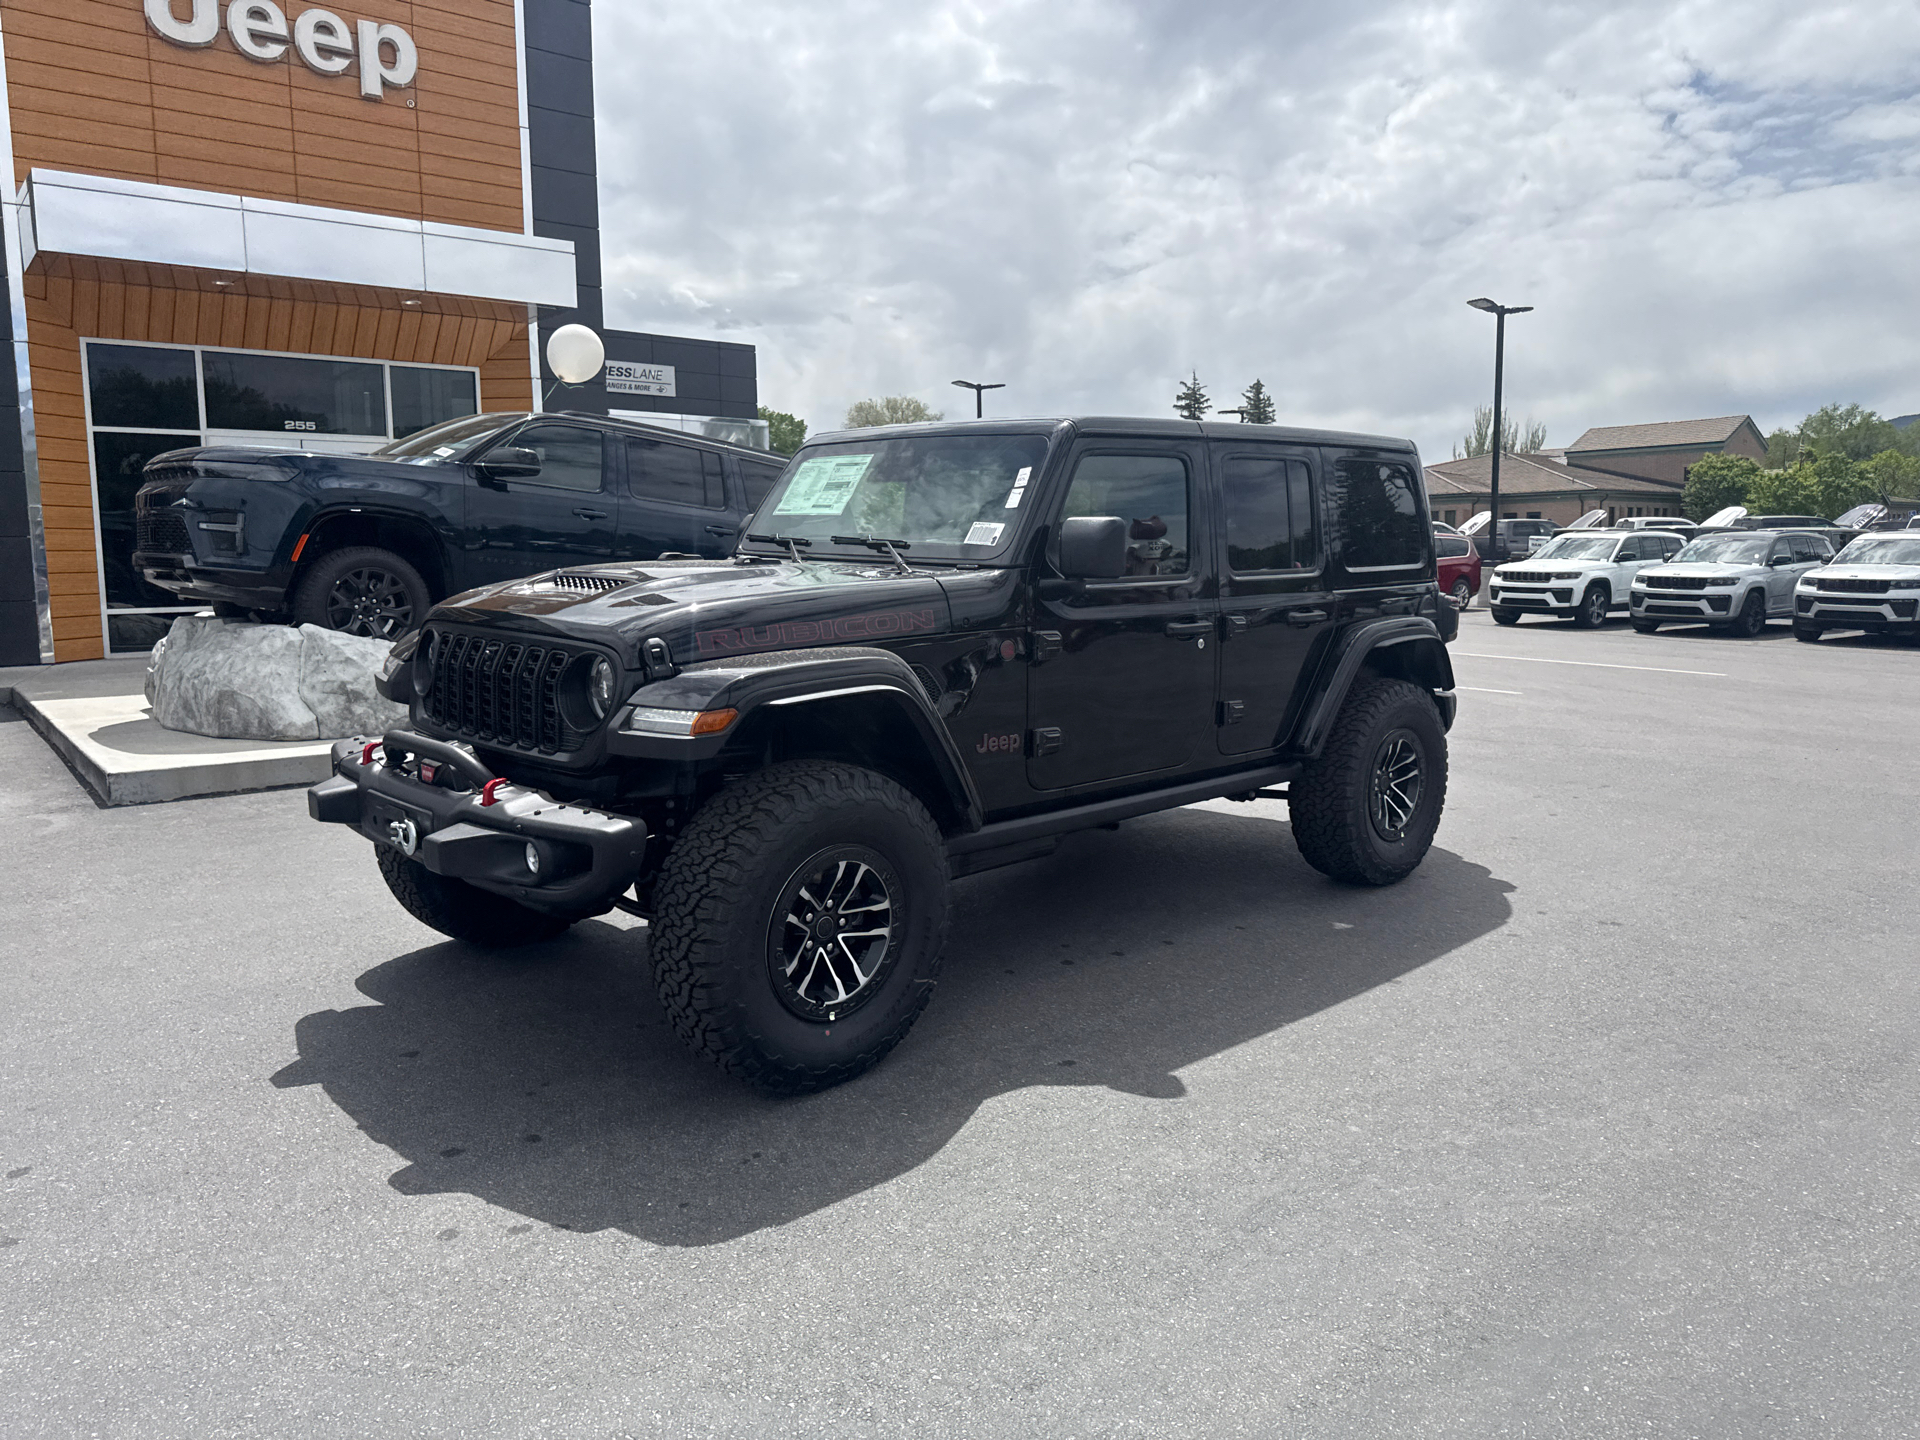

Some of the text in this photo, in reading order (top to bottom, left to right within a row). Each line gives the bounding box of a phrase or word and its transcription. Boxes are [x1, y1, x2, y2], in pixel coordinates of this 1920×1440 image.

[144, 0, 419, 101] Jeep
[606, 382, 627, 390] ANGES
[633, 384, 651, 392] MORE
[284, 420, 316, 431] 255
[696, 609, 935, 653] RUBICON
[975, 733, 1021, 753] Jeep
